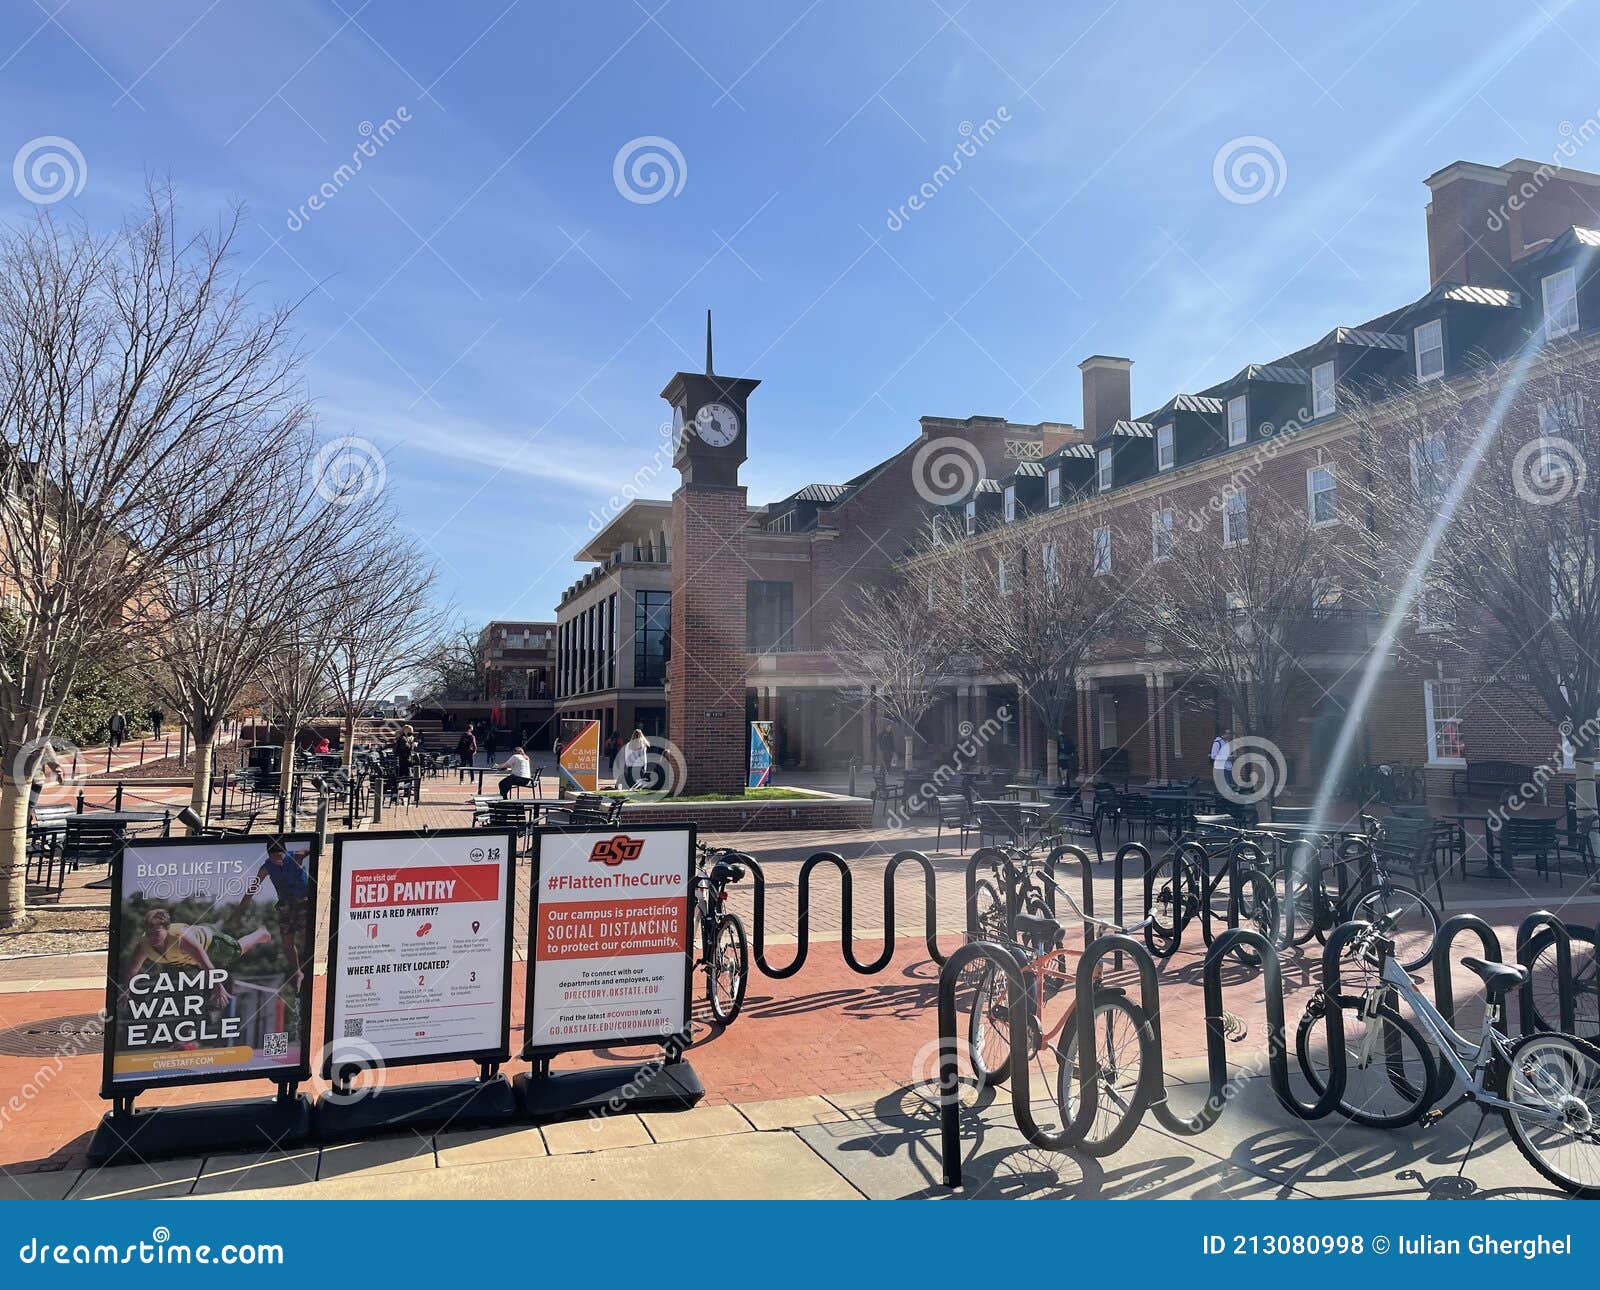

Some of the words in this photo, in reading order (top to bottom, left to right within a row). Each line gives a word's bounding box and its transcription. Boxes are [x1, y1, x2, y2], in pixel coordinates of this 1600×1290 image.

[588, 834, 645, 866] OSU
[138, 863, 178, 878] BLOB
[182, 861, 213, 876] LIKE
[216, 860, 243, 874] IT'S
[356, 874, 372, 882] Come
[374, 874, 386, 882] visit
[548, 872, 681, 890] #FlattenTheCurve
[138, 878, 213, 900] YOUR
[216, 876, 262, 900] JOB
[356, 883, 388, 904] RED
[394, 880, 456, 902] PANTRY
[350, 910, 371, 920] WHAT
[373, 909, 381, 919] IS
[382, 909, 388, 918] A
[390, 908, 405, 918] RED
[406, 906, 439, 918] PANTRY?
[548, 910, 568, 921] Our
[570, 910, 612, 922] campus
[615, 908, 624, 918] is
[626, 906, 678, 920] practicing
[548, 924, 594, 940] SOCIAL
[600, 919, 678, 938] DISTANCING
[548, 944, 558, 953] to
[560, 942, 598, 954] protect
[601, 942, 618, 950] our
[620, 937, 678, 950] community.
[346, 965, 374, 976] WHERE
[376, 964, 391, 974] ARE
[392, 962, 412, 973] THEY
[414, 960, 450, 971] LOCATED?
[590, 970, 616, 978] connect
[618, 968, 632, 976] with
[128, 968, 229, 996] CAMP
[366, 978, 372, 990] 1
[418, 975, 424, 986] 2
[470, 972, 476, 982] 3
[558, 979, 600, 988] departments
[602, 978, 614, 986] and
[615, 975, 650, 985] employees,
[564, 985, 658, 1000] DIRECTORY.OKSTATE.EDU
[128, 996, 204, 1020] WAR
[559, 1014, 574, 1022] Find
[587, 1012, 606, 1020] latest
[606, 1010, 638, 1018] #COVID19
[640, 1008, 652, 1016] info
[128, 1018, 241, 1046] EAGLE
[550, 1018, 670, 1036] GO.OKSTATE.EDU/CORONAVIRUS
